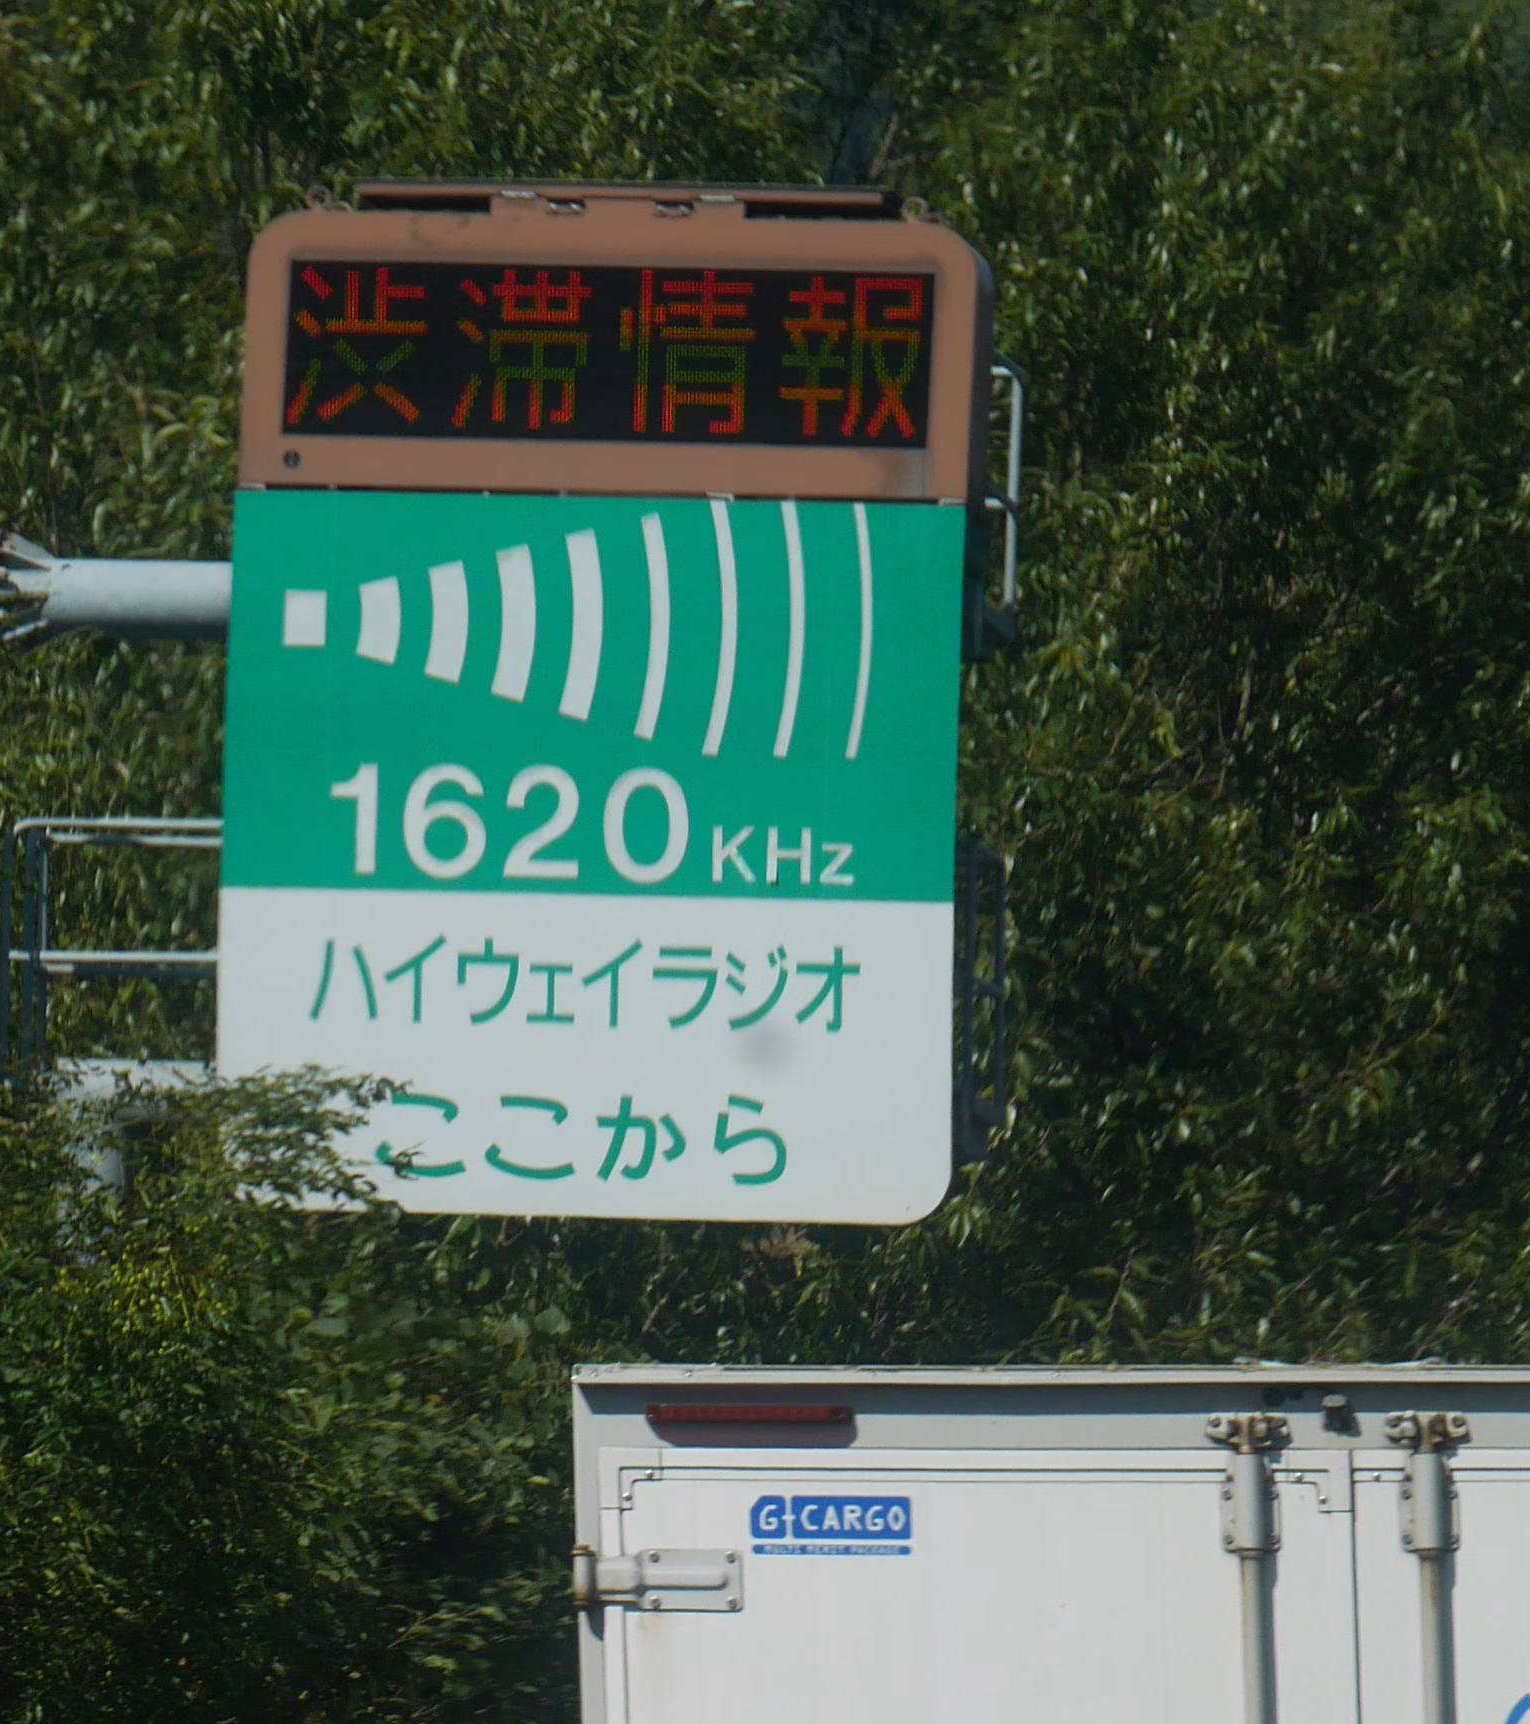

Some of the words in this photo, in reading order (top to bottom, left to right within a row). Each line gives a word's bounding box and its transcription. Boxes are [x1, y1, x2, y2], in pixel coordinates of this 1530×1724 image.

[284, 265, 926, 440] 渋滞情報
[329, 761, 691, 884] 1620
[709, 826, 855, 887] KHz
[309, 934, 862, 1033] ハイウェイラジオ
[375, 1091, 789, 1186] ここから
[759, 1503, 907, 1532] G-CARGO
